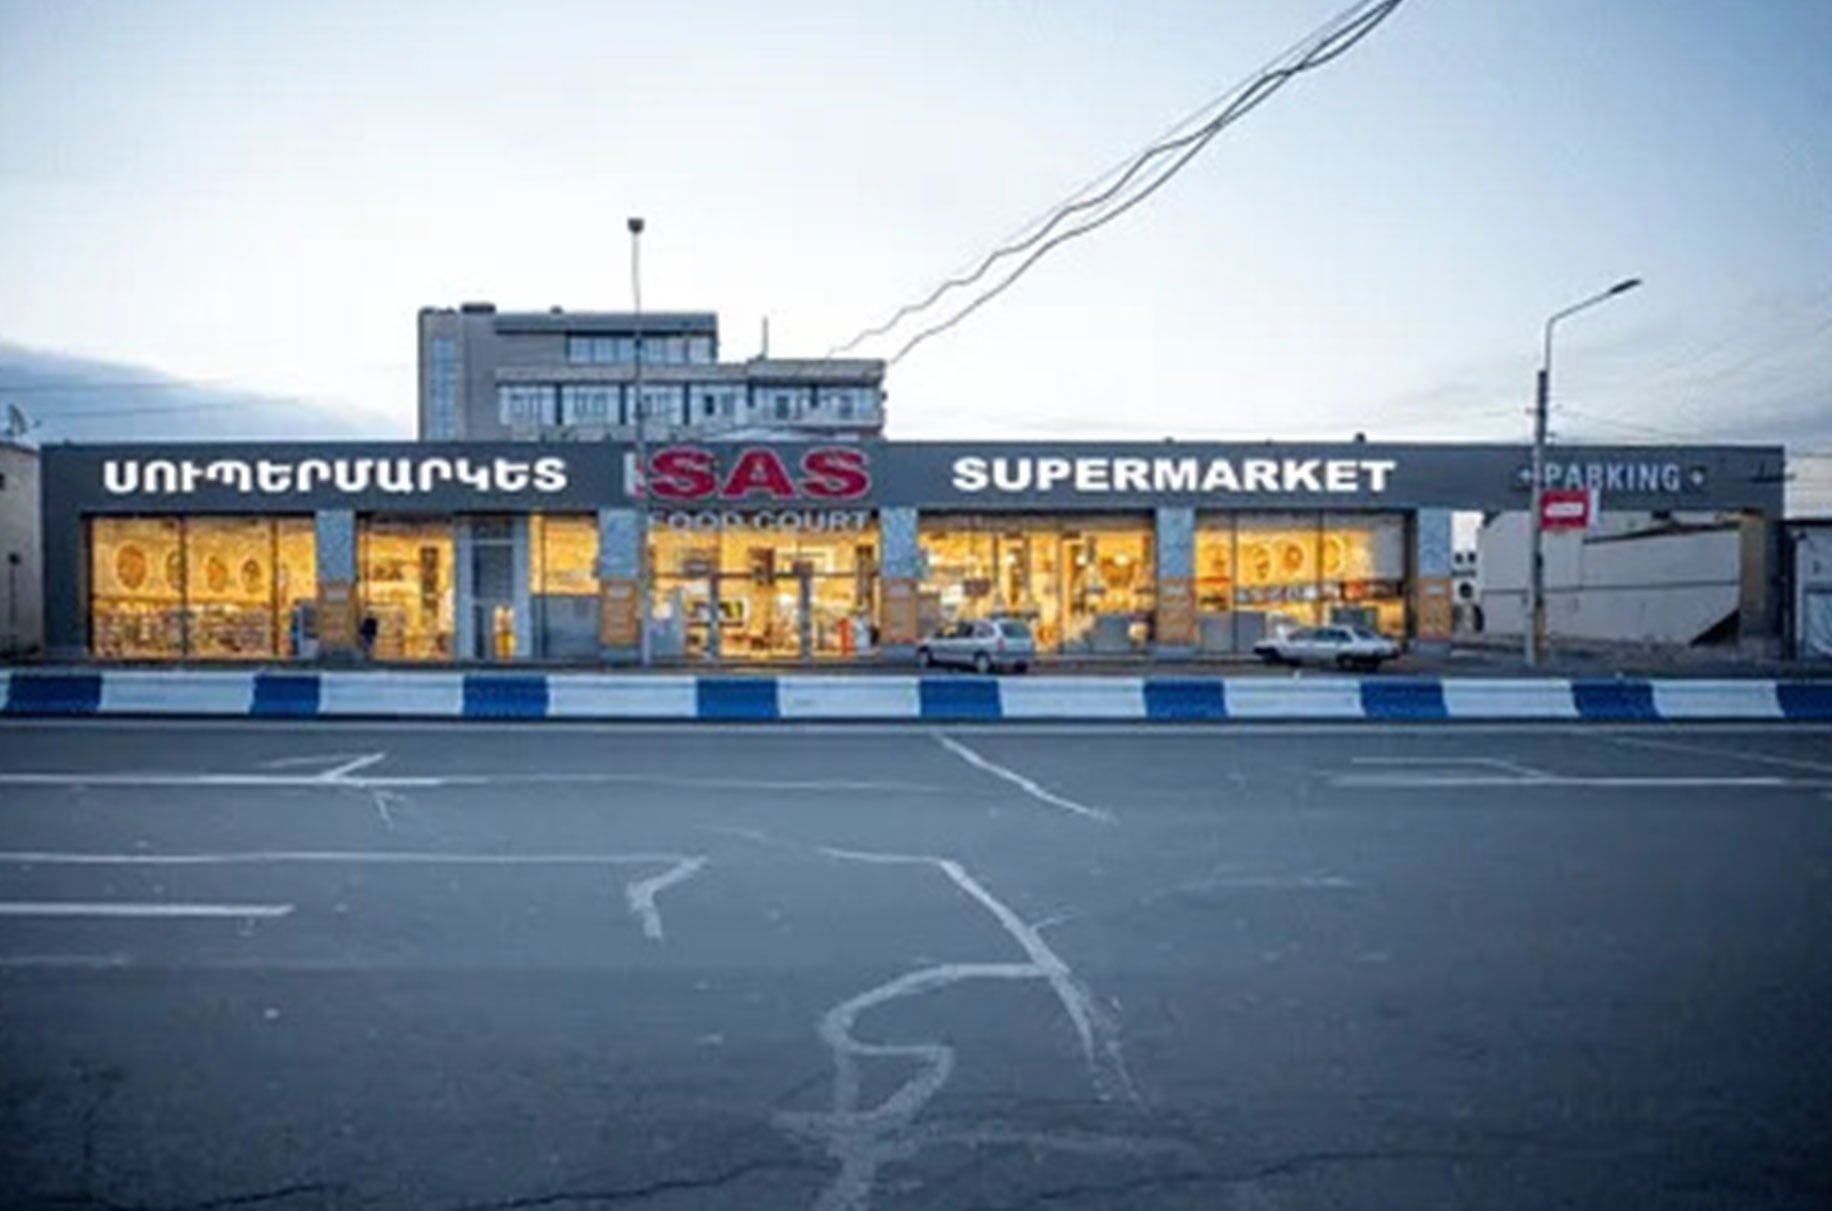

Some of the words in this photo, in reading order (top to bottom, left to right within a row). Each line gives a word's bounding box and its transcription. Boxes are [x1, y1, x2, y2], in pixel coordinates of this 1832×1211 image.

[103, 458, 567, 493] ՍՈՒՊԵՐՄԱՐԿԵՏ
[650, 447, 872, 499] SAS
[952, 457, 1396, 492] SUPERMARKET
[648, 511, 743, 533] FOOD
[753, 511, 869, 531] COURT
